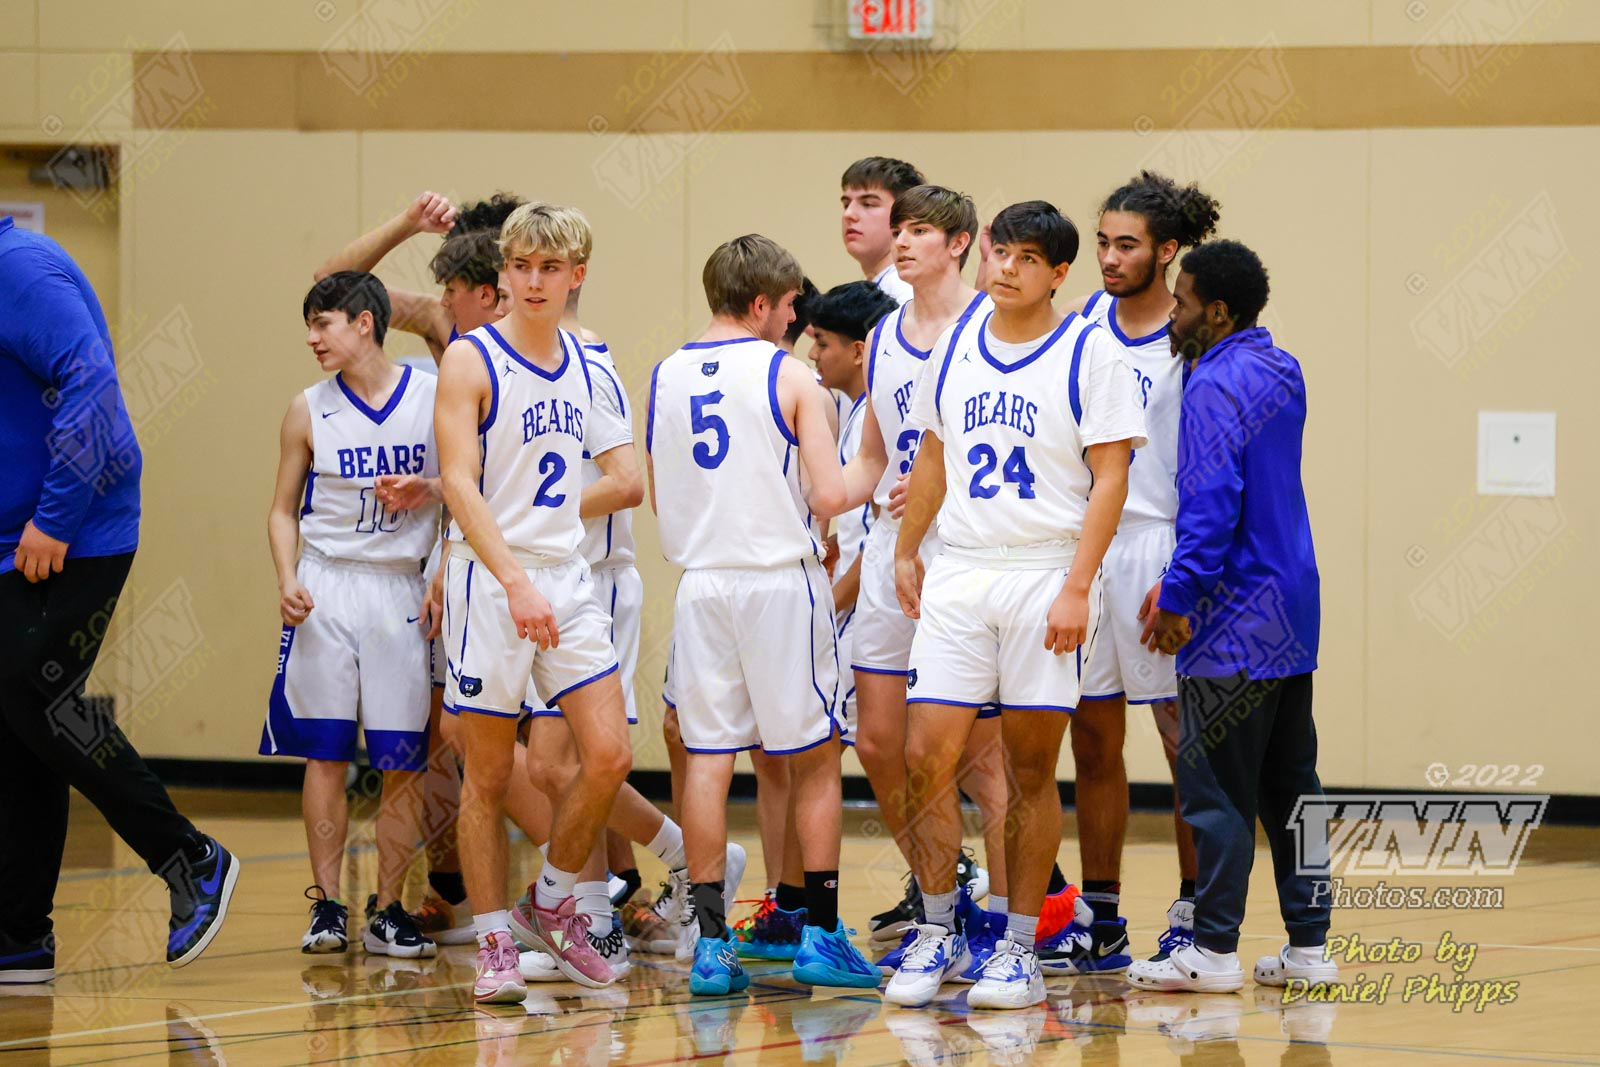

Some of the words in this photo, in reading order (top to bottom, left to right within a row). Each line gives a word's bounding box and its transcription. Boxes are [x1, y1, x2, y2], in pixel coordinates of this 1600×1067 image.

[861, 0, 917, 34] EXIT
[522, 399, 583, 445] BEARS
[690, 390, 731, 469] 5
[963, 391, 1038, 438] BEARS
[337, 443, 426, 479] BEARS
[533, 451, 567, 508] 2
[967, 443, 1036, 499] 24
